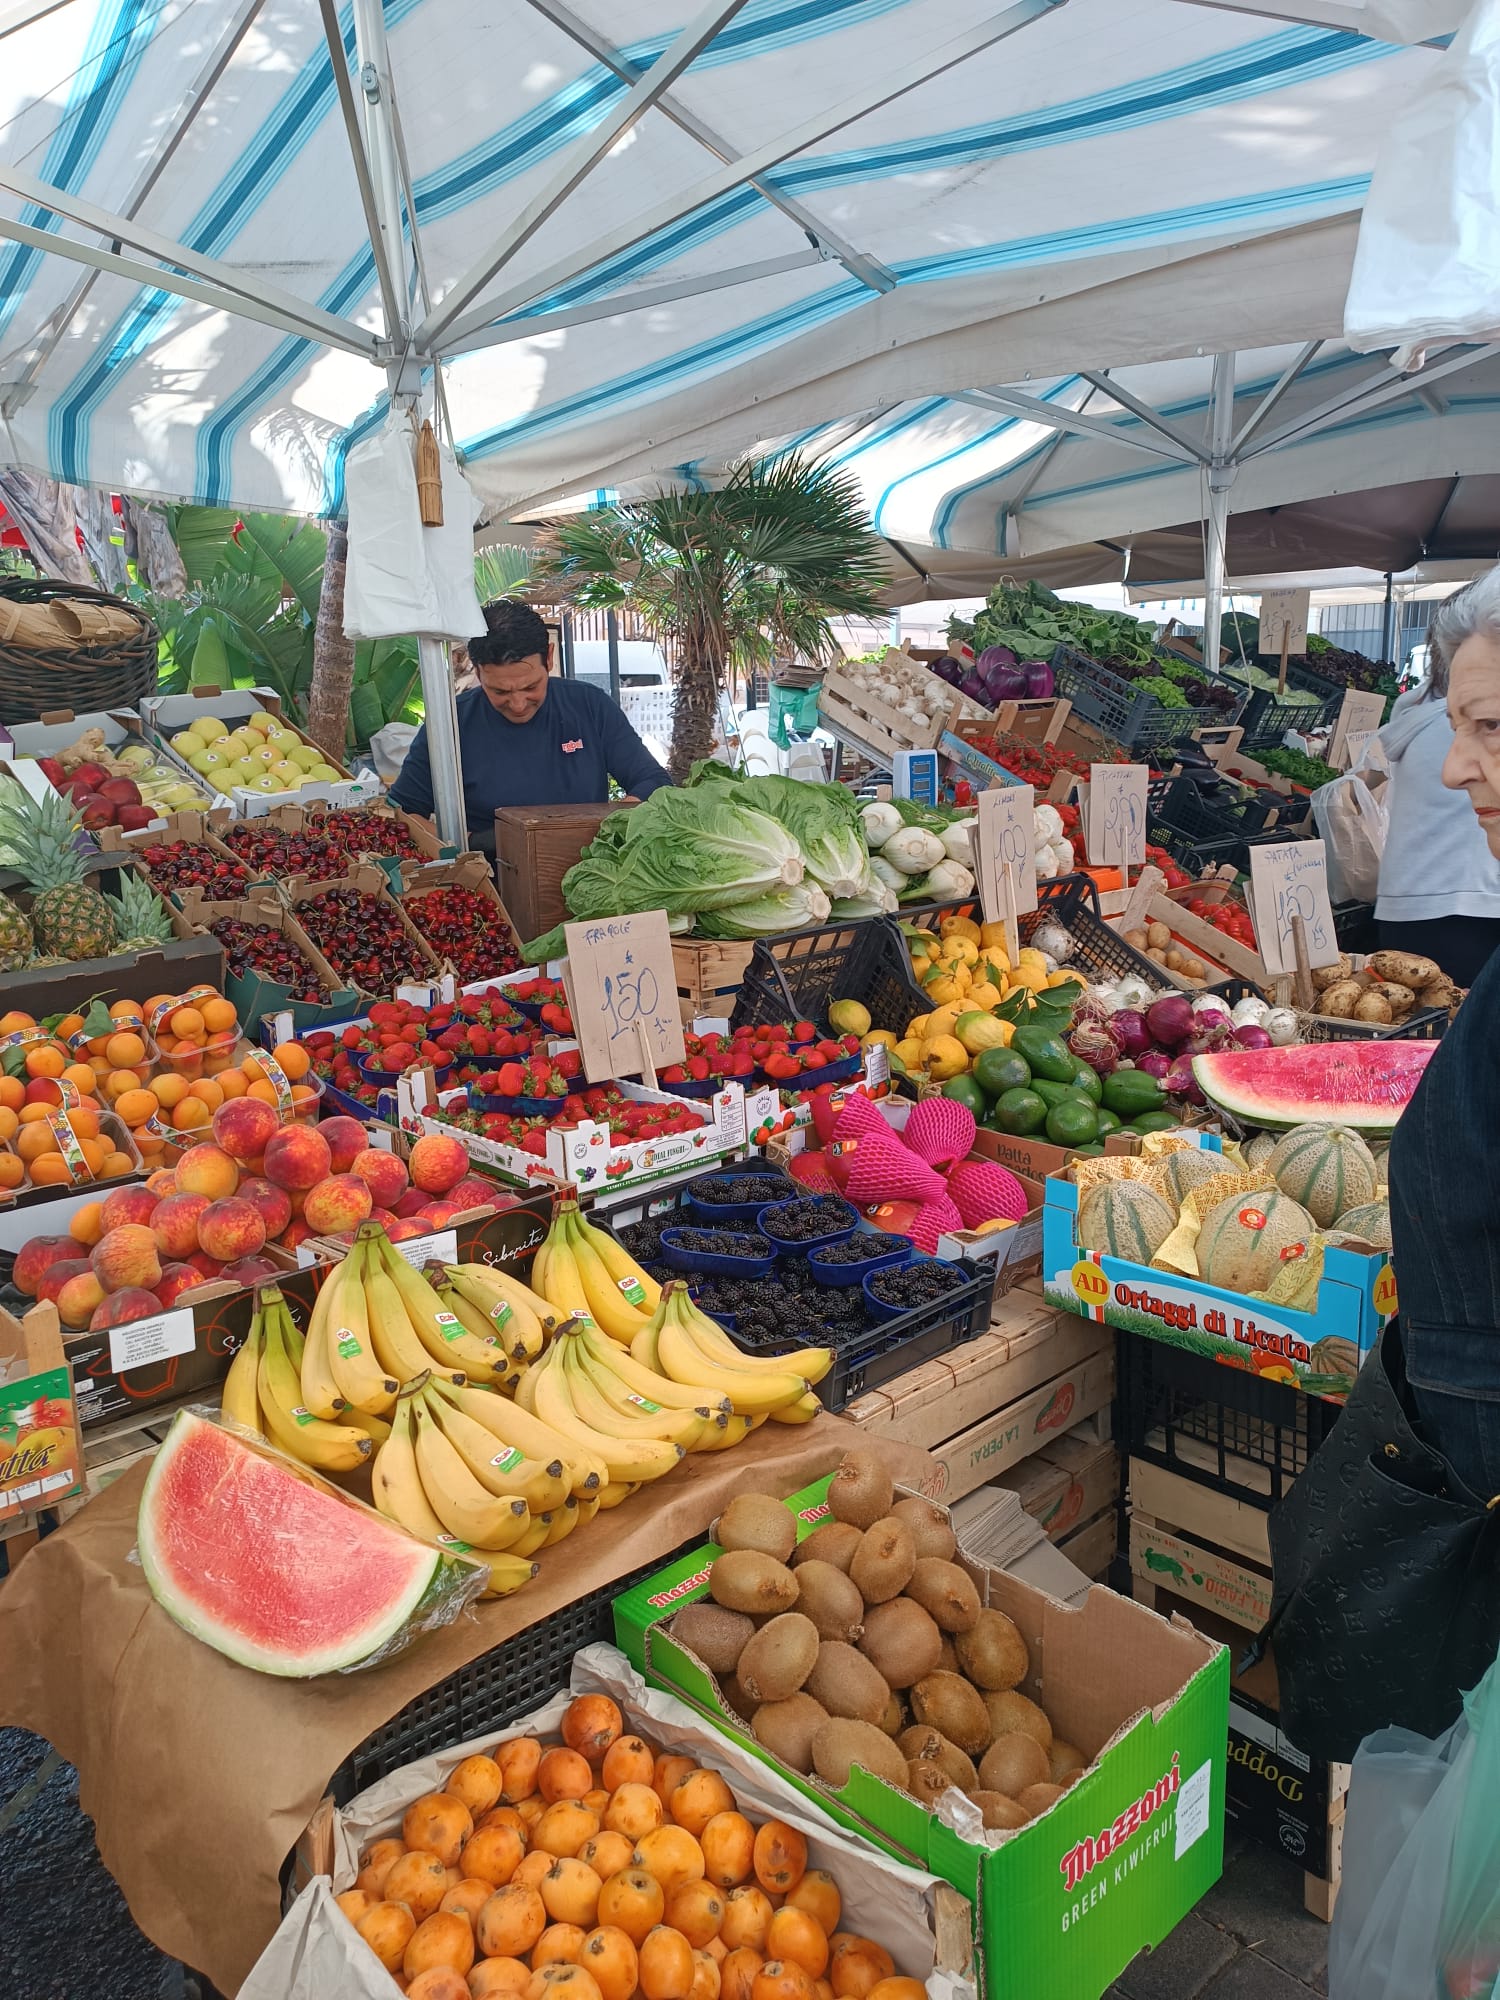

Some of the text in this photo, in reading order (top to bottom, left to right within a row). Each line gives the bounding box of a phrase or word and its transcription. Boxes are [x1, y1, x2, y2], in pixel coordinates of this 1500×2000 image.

[1075, 1273, 1107, 1296] AD
[1115, 1283, 1312, 1364] Ortaggi di Licata
[648, 1561, 713, 1608] Mazzo
[1227, 1740, 1304, 1801] Doppi
[1060, 1750, 1181, 1892] Mazzoni
[1062, 1877, 1107, 1932] GREEN
